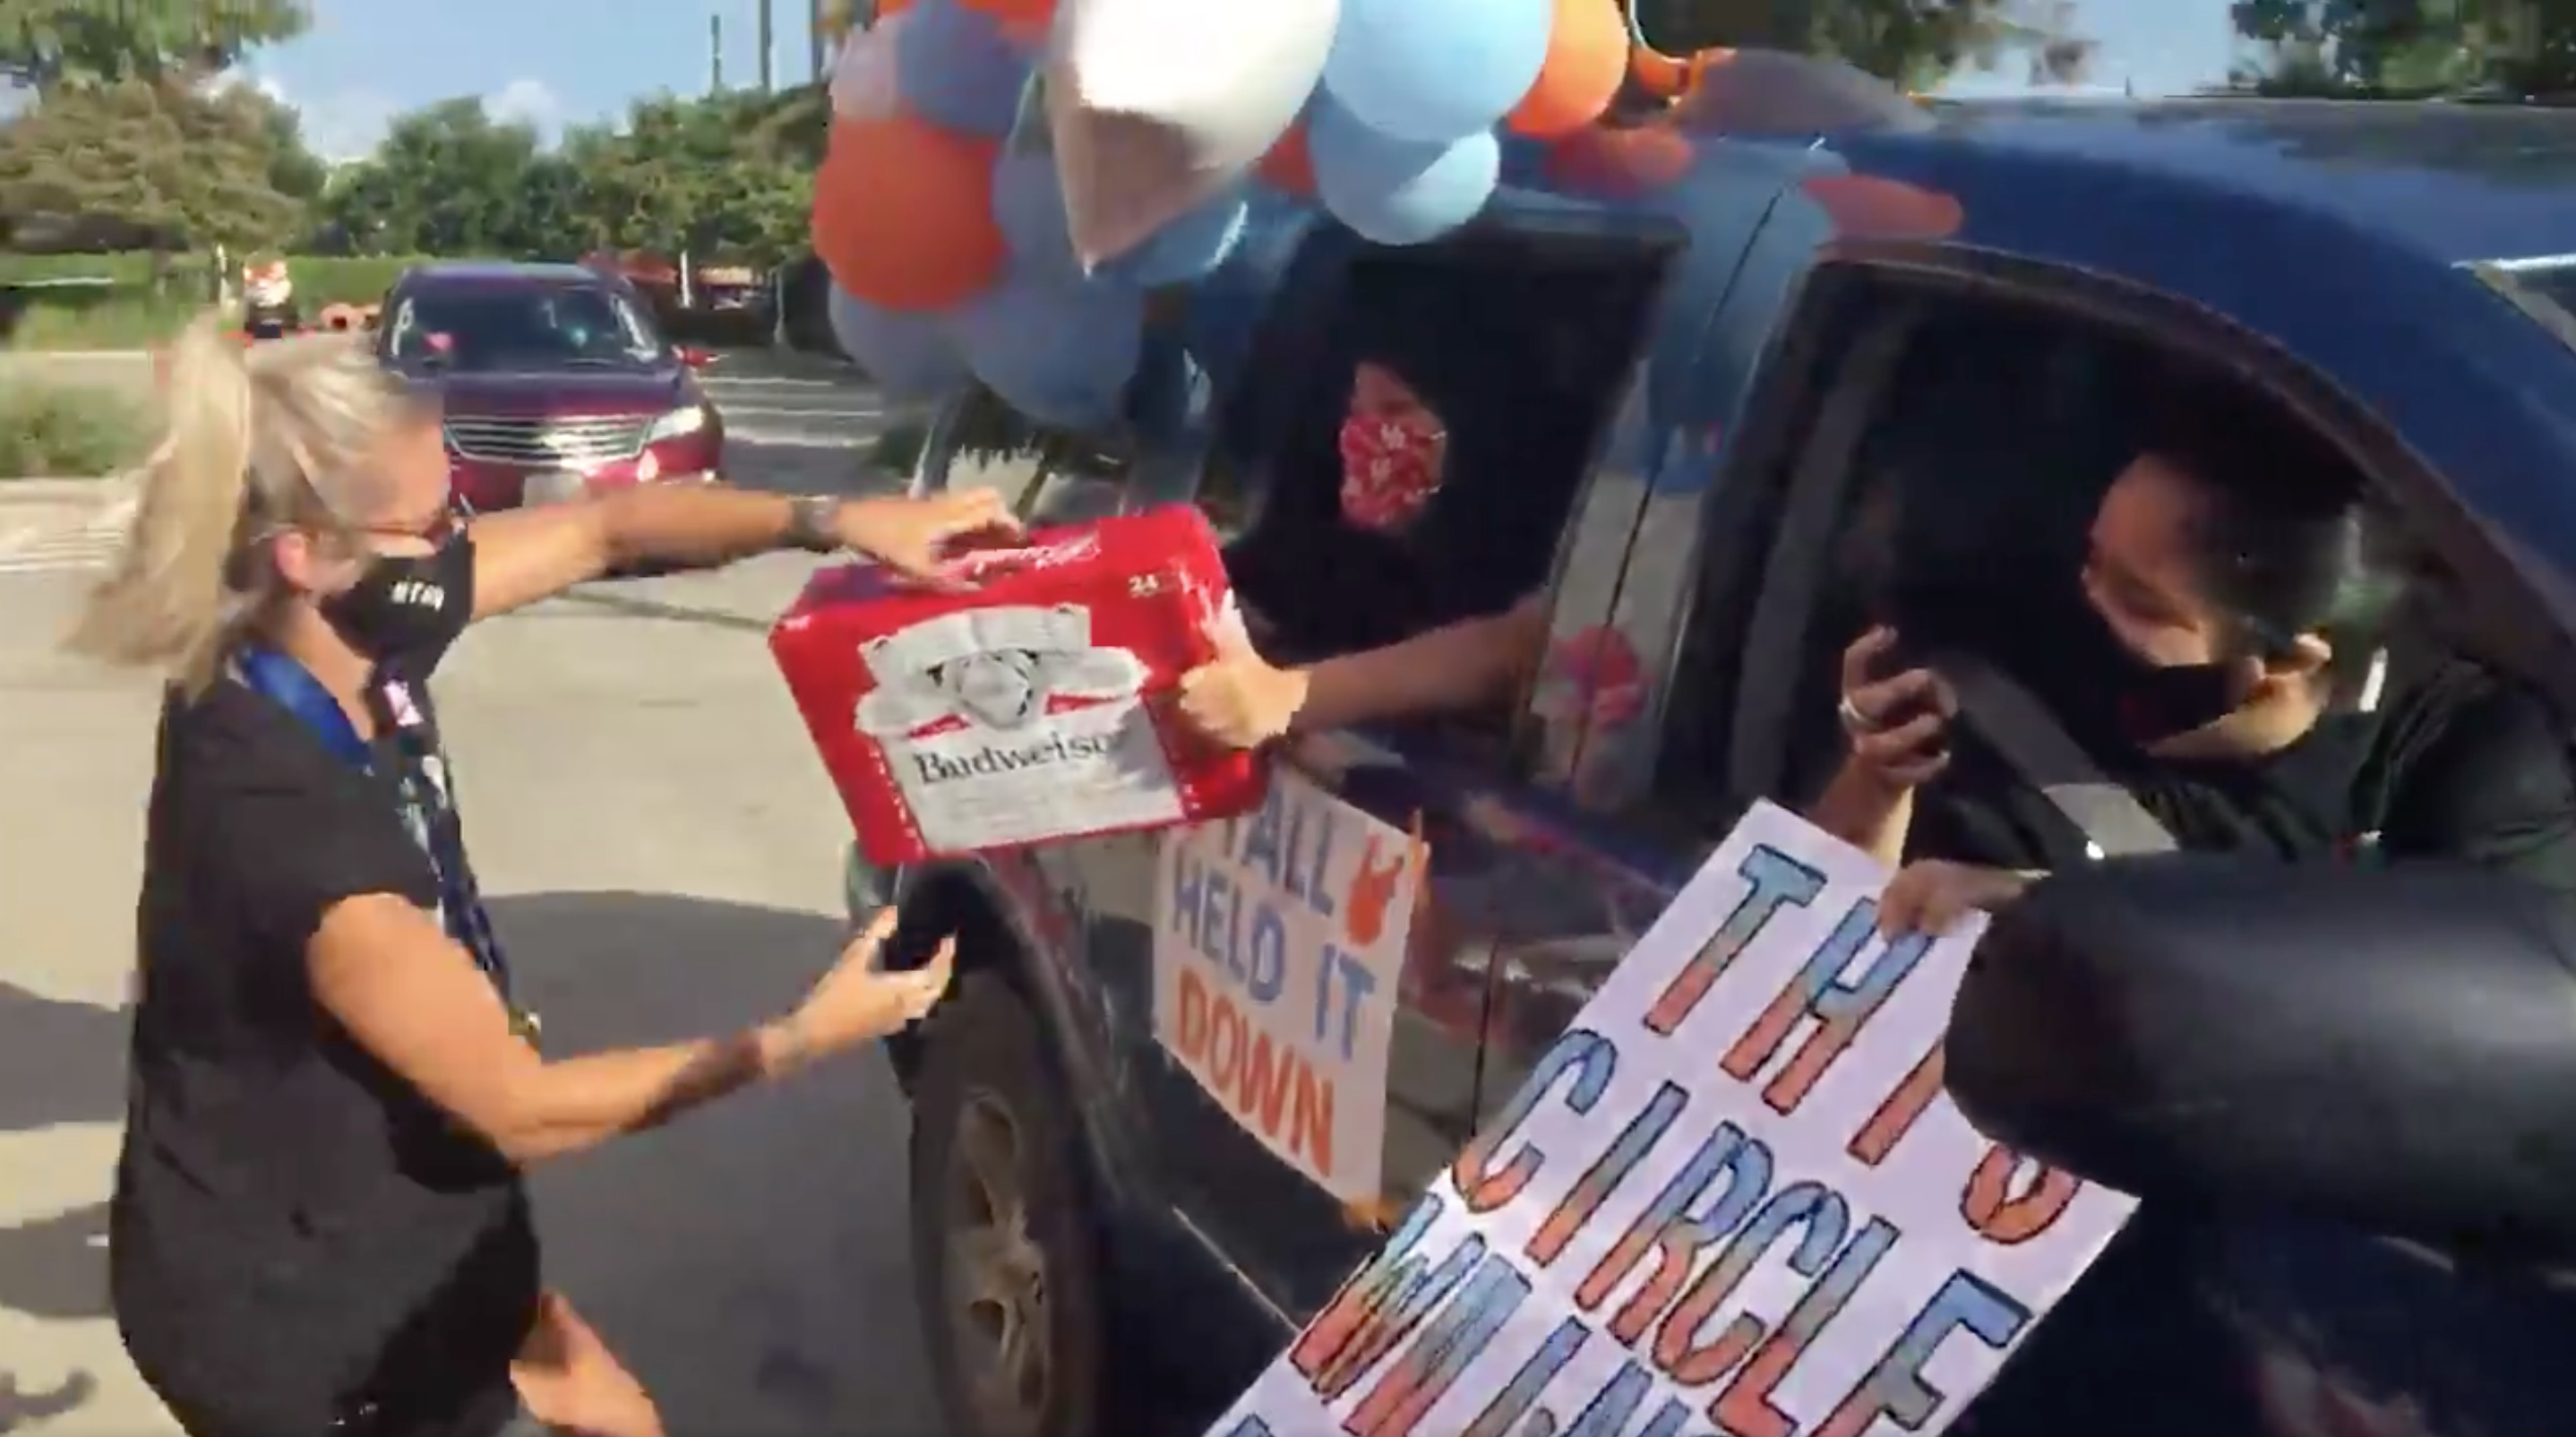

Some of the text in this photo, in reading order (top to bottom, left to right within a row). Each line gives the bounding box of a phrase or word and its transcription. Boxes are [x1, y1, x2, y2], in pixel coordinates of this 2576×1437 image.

[913, 731, 1121, 784] Budweise
[1173, 844, 1377, 1063] HELD IT
[1177, 963, 1333, 1178] DOWN
[1451, 1028, 2031, 1437] CIRCLE
